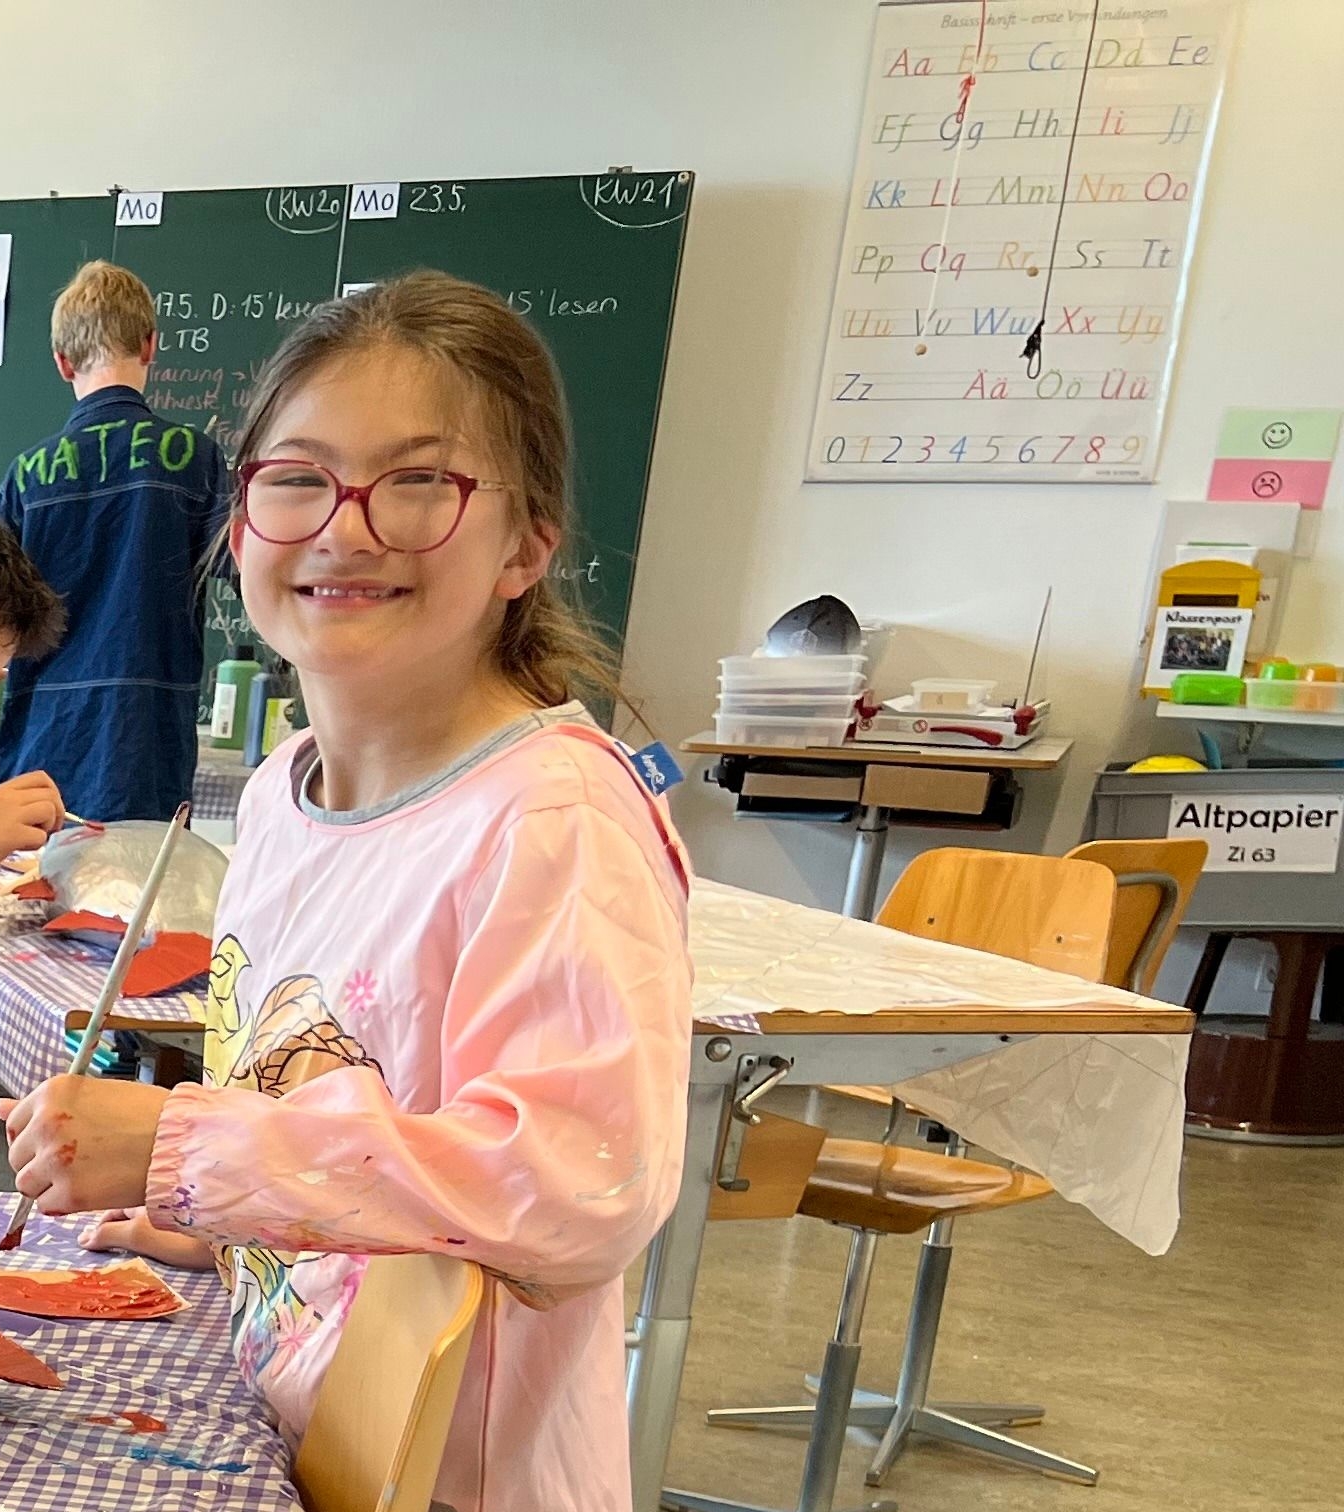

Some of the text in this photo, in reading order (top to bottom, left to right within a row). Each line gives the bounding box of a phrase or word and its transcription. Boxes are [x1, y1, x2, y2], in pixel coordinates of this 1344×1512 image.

[887, 47, 933, 77] Aa
[1028, 41, 1066, 71] Cc
[1094, 38, 1144, 69] Dd
[1169, 35, 1210, 66] Ee
[877, 113, 917, 153] Ff
[939, 111, 984, 152] Gg
[1014, 108, 1060, 138] Hh
[1158, 105, 1194, 145] Jj
[354, 189, 394, 212] Mo
[409, 183, 466, 213] 23.5.
[593, 176, 676, 208] KW21
[866, 180, 907, 209] Kk
[985, 176, 1057, 205] Mm
[1075, 173, 1127, 203] Nn
[1144, 172, 1190, 202] Oo
[118, 198, 158, 220] Mo
[856, 238, 1173, 284] Pp Qq Rr Ss Tt
[549, 287, 618, 317] lesen
[845, 304, 1165, 345] Uu Vv Ww Xx Yy
[836, 366, 1150, 401] Zz Ää Öö Üü
[16, 419, 195, 493] MATEO
[825, 435, 1142, 464] 0 1 2 3 4 5 6 7 8 9
[1165, 610, 1243, 627] Klassenpost
[1174, 803, 1339, 834] Altpapier
[1227, 846, 1276, 863] Zi 63
